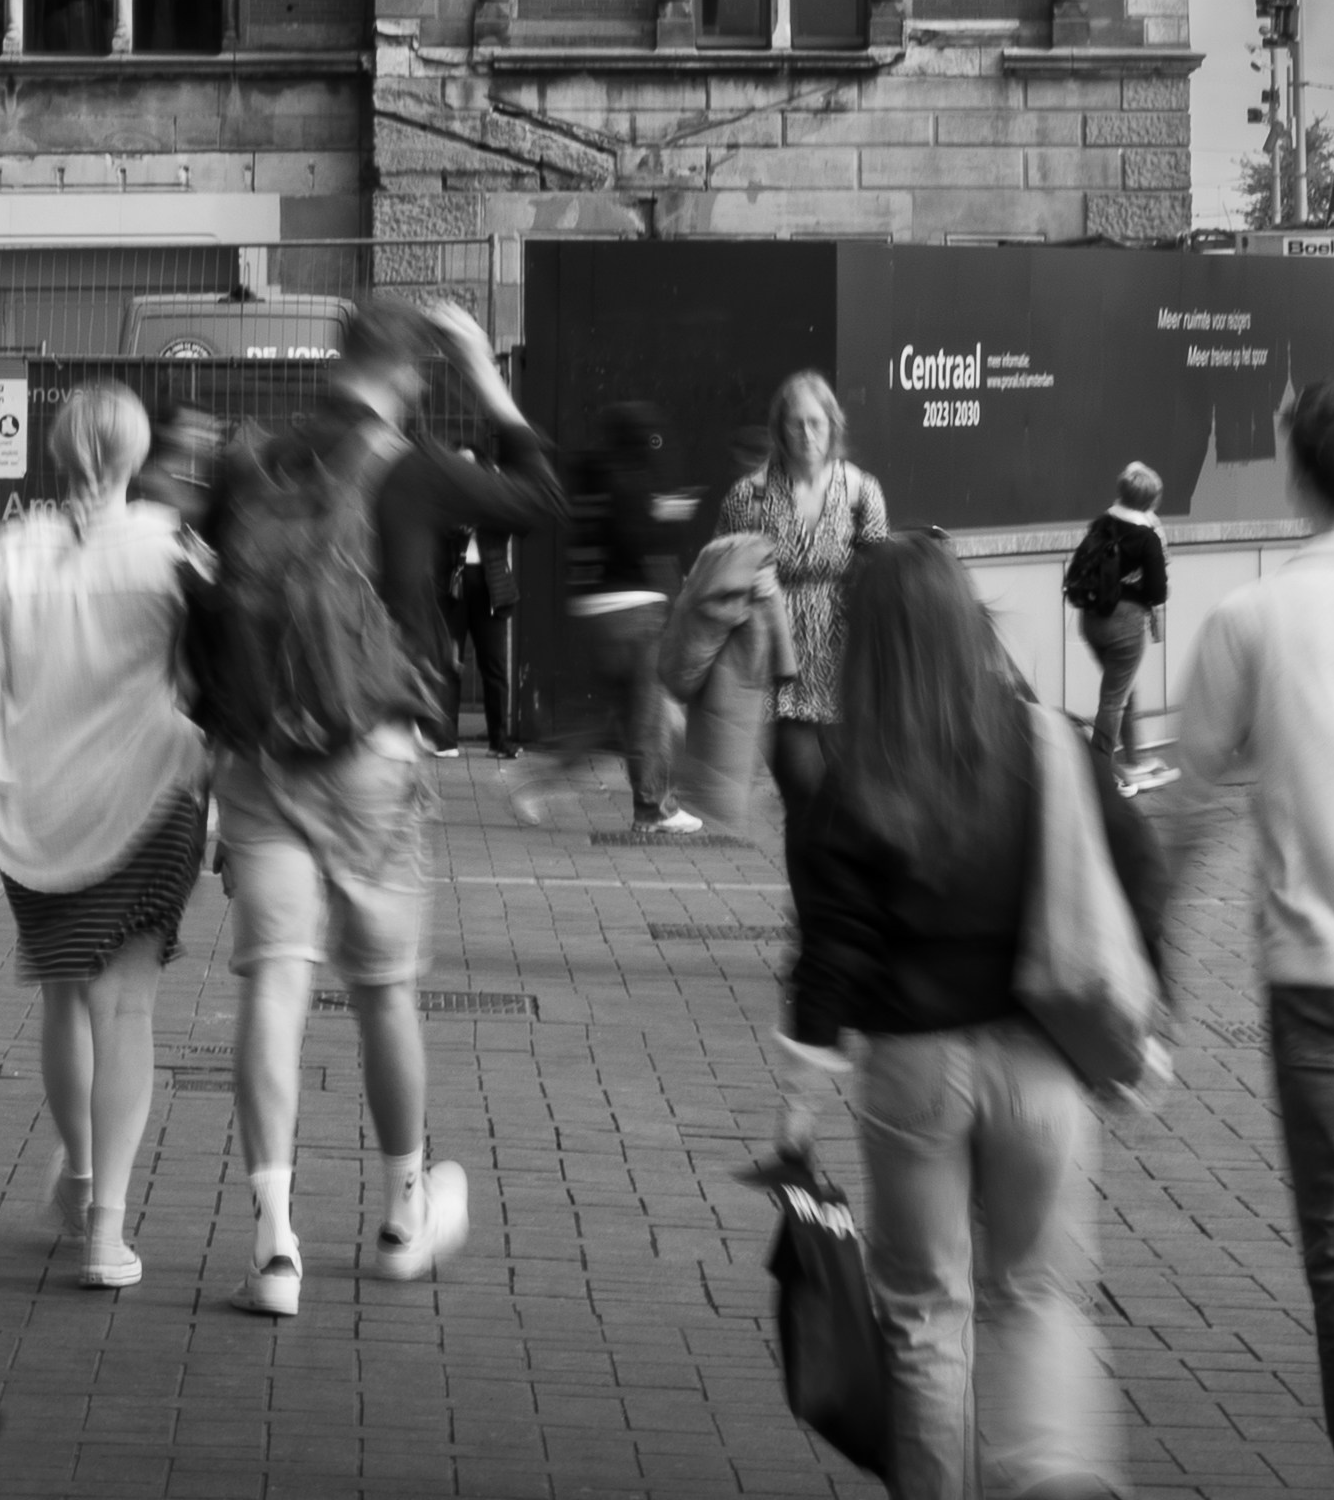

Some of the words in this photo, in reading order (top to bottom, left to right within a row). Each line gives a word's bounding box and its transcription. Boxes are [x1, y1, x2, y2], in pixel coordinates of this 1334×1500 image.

[1157, 306, 1183, 330] Meer
[900, 341, 981, 391] Centraal
[1187, 344, 1210, 367] Meer
